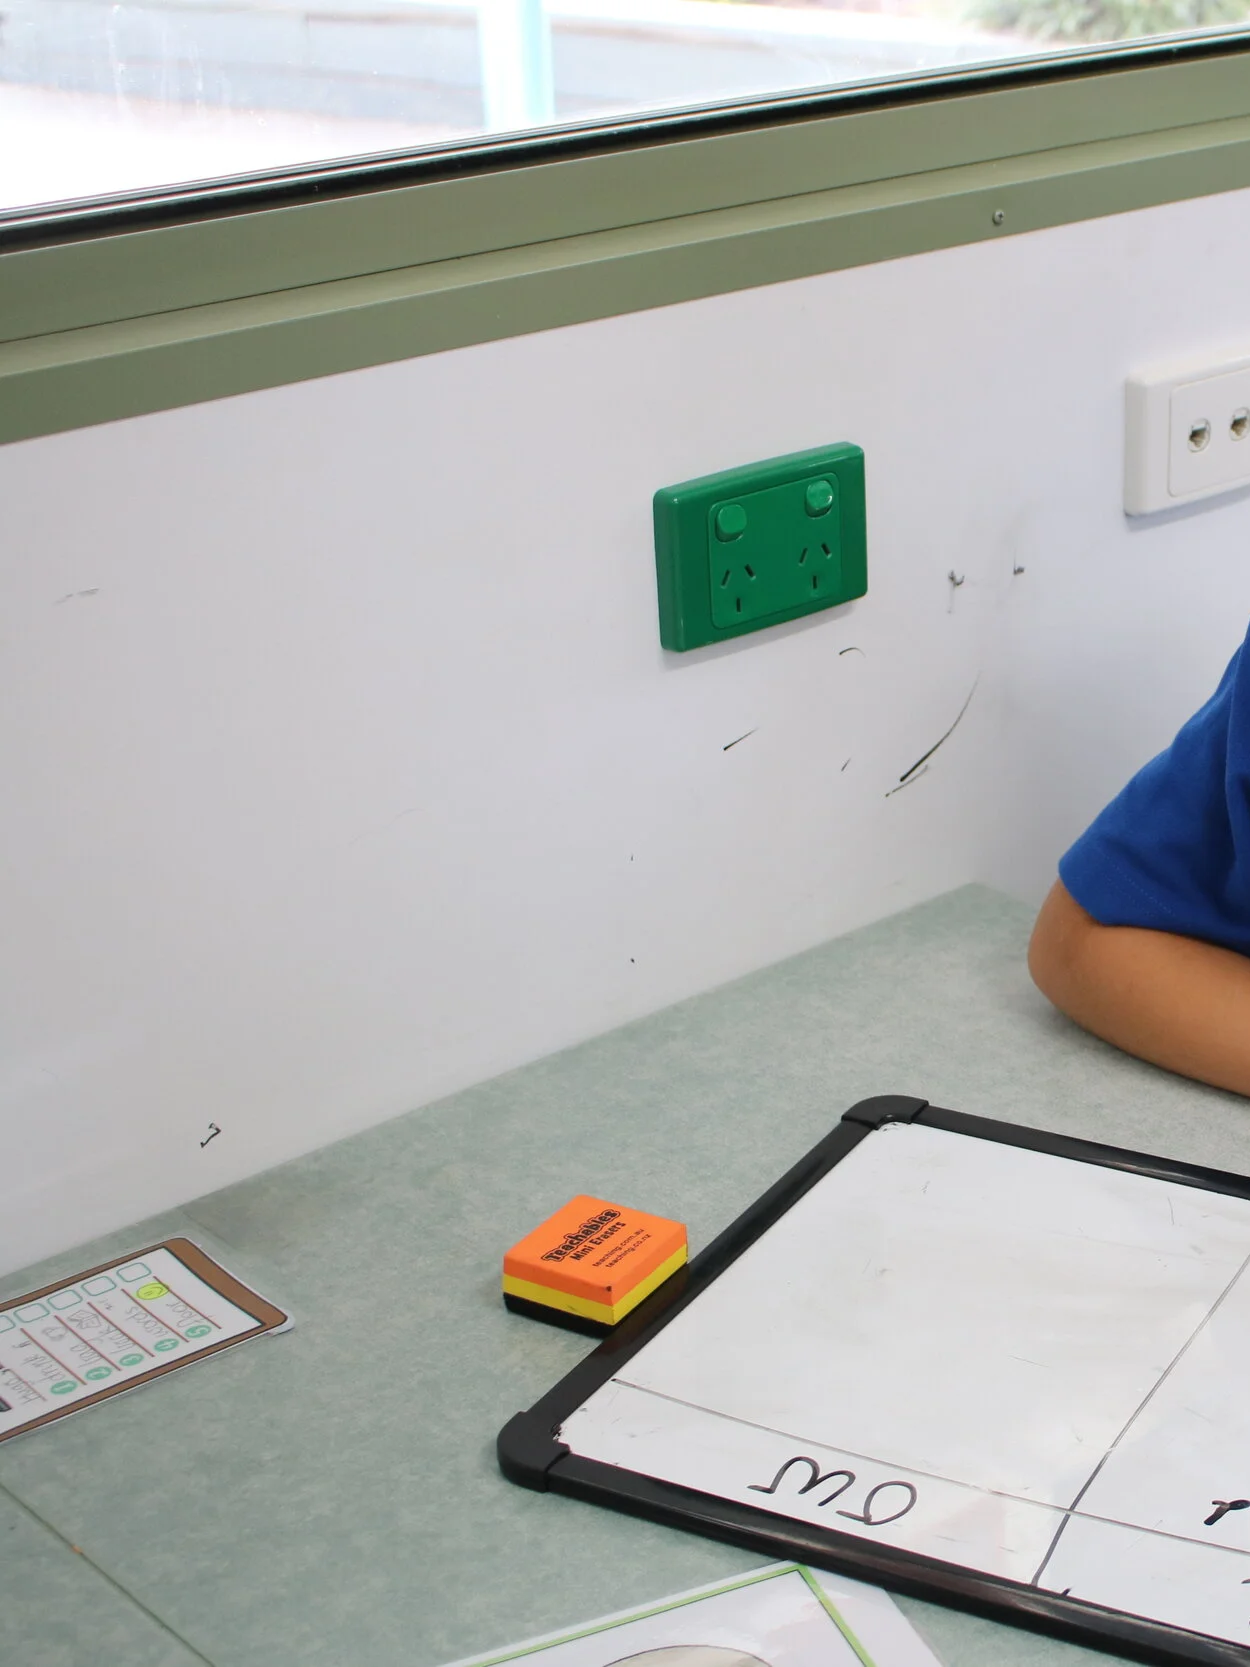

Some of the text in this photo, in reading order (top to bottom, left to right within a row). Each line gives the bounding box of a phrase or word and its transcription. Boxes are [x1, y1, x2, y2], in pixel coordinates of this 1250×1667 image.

[541, 1209, 620, 1262] Teachables
[570, 1221, 626, 1260] Mini Erasers
[592, 1229, 645, 1267] teaching.com.au
[606, 1233, 651, 1268] teaching.co.nz
[125, 1305, 170, 1337] words
[746, 1456, 918, 1526] ow
